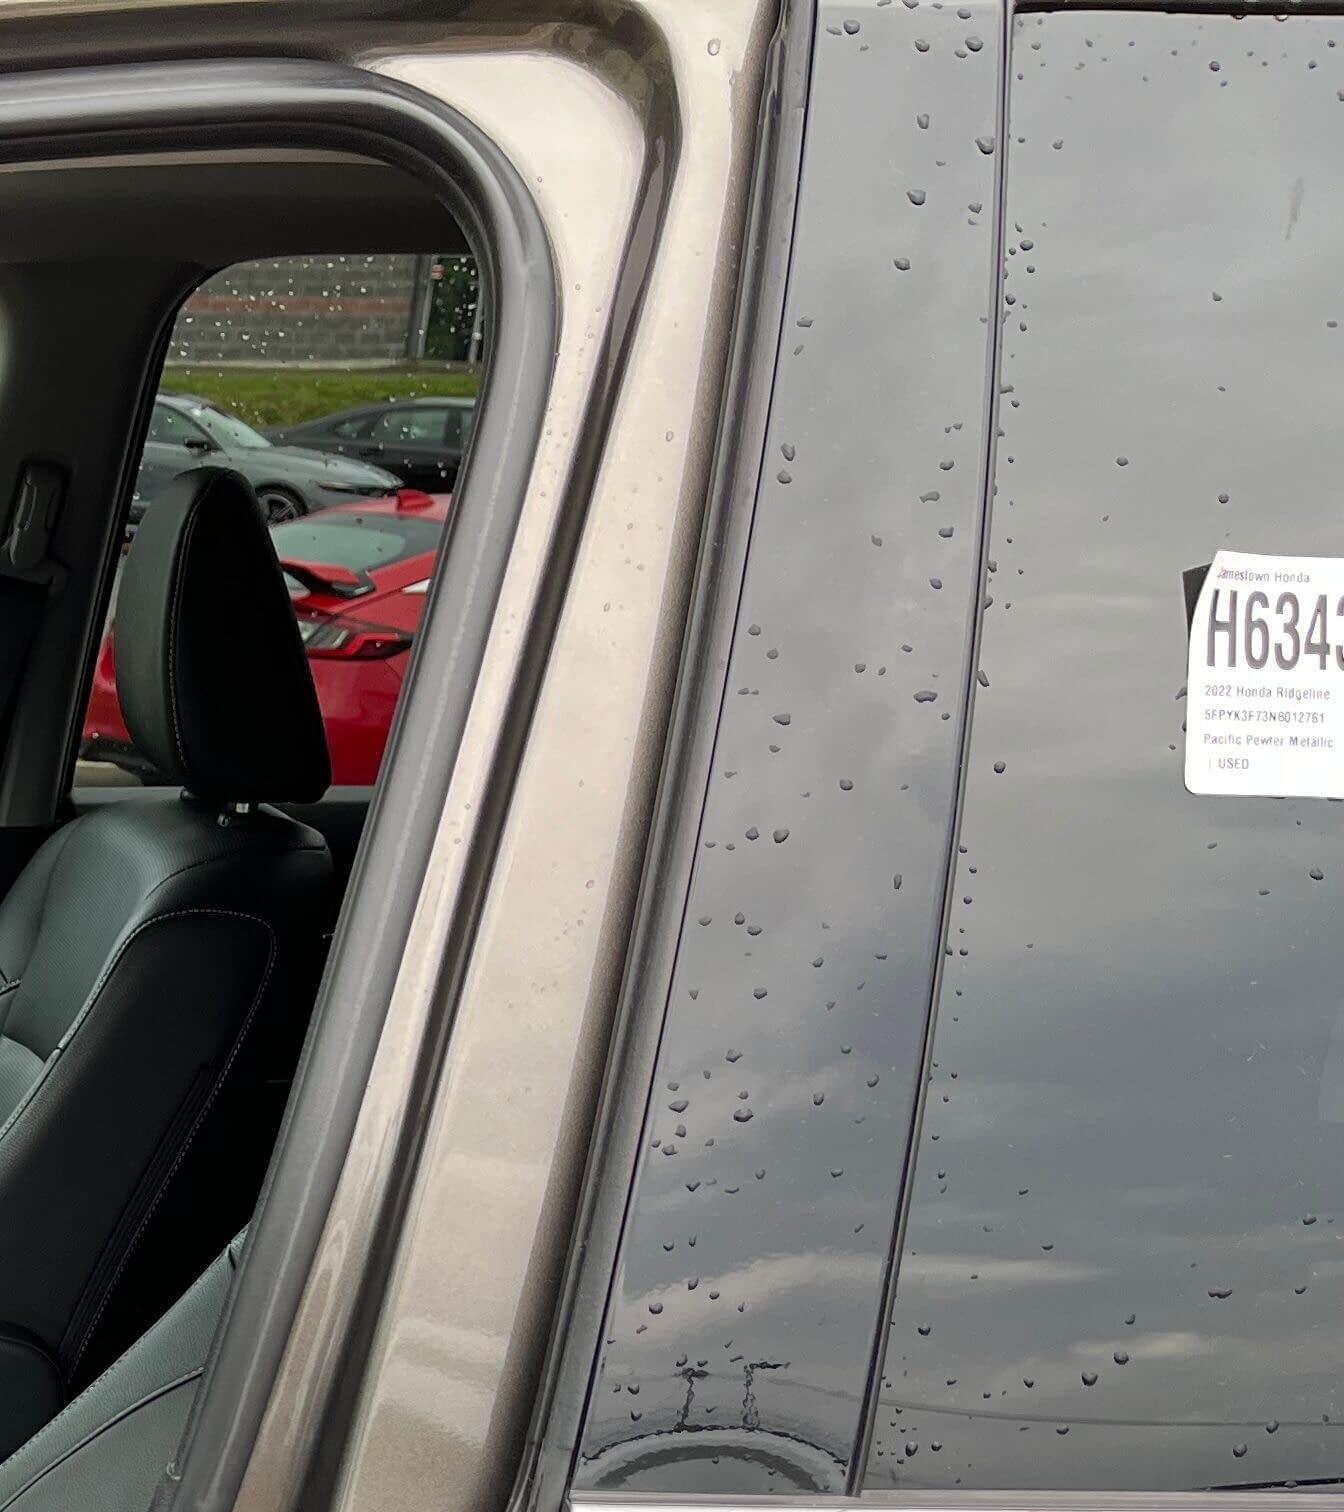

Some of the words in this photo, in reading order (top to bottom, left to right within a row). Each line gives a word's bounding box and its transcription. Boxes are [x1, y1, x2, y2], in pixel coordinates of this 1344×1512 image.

[1217, 567, 1270, 582] Jamestown
[1274, 571, 1310, 583] Honda
[1204, 684, 1232, 697] 2022
[1236, 686, 1272, 698] Honda
[1276, 687, 1330, 701] Ridgeline
[1203, 733, 1242, 745] Pacific
[1246, 735, 1284, 747] Pewter
[1289, 736, 1334, 748] Metallic
[1218, 757, 1249, 769] USED
